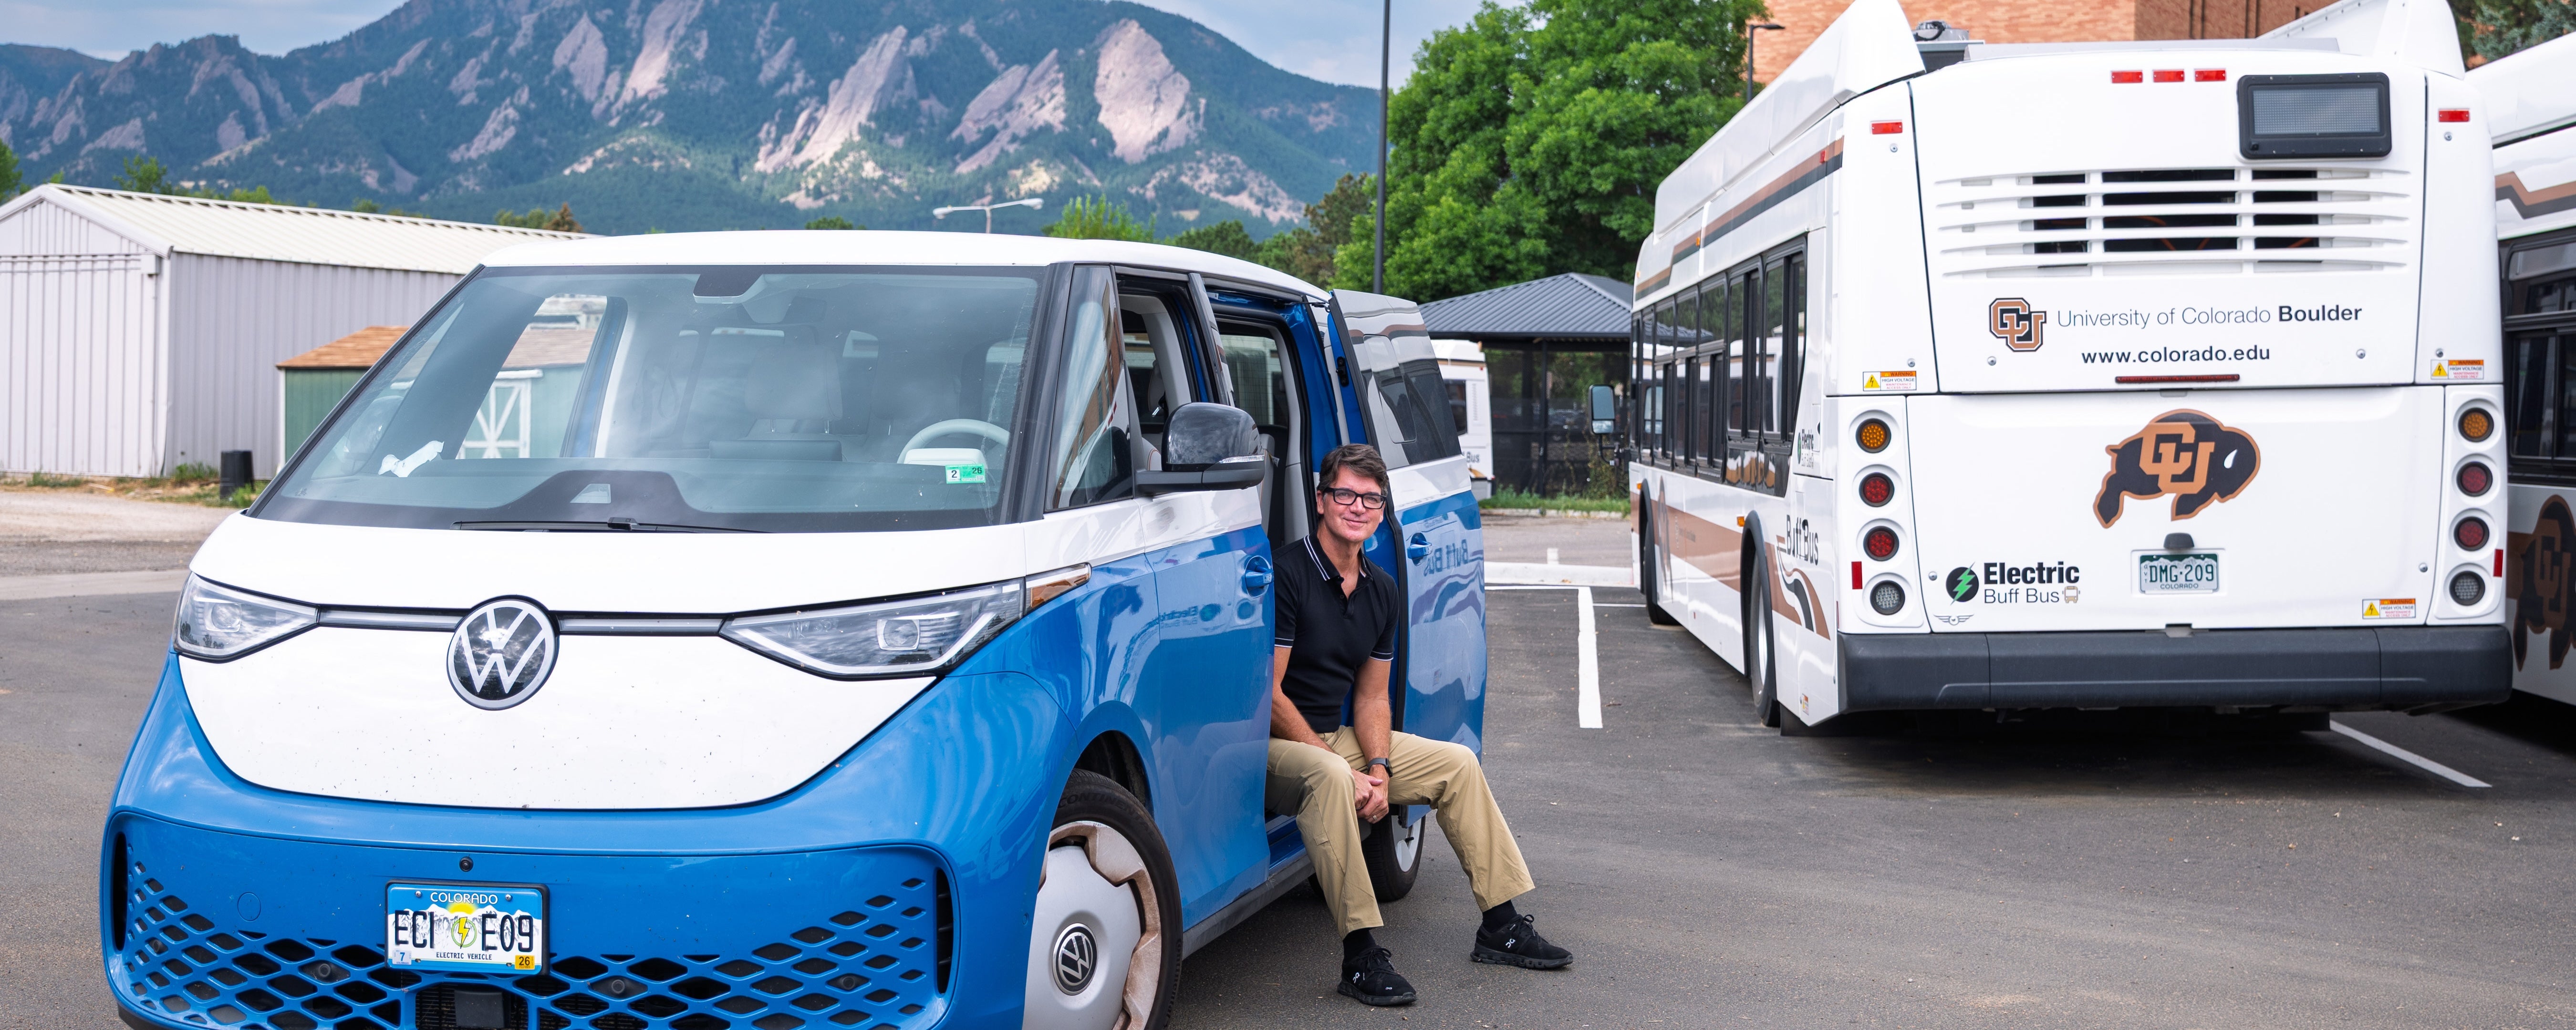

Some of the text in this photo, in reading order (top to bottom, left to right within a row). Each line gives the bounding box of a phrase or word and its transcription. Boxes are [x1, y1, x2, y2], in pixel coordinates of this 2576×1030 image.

[2057, 305, 2362, 329] University of Colorado Boulder
[2081, 345, 2270, 363] www.colorado.edu
[1466, 451, 1480, 463] Bus
[951, 470, 957, 478] 2
[1786, 514, 1818, 566] Buff Bus
[1984, 561, 2079, 585] Electric
[1984, 588, 2059, 603] Buff Bus
[454, 602, 551, 701] VW
[430, 892, 499, 905] COLORADO
[394, 909, 534, 953] ECI E09
[400, 952, 405, 961] 7
[436, 952, 465, 960] ELECTRIC
[519, 956, 530, 966] 26
